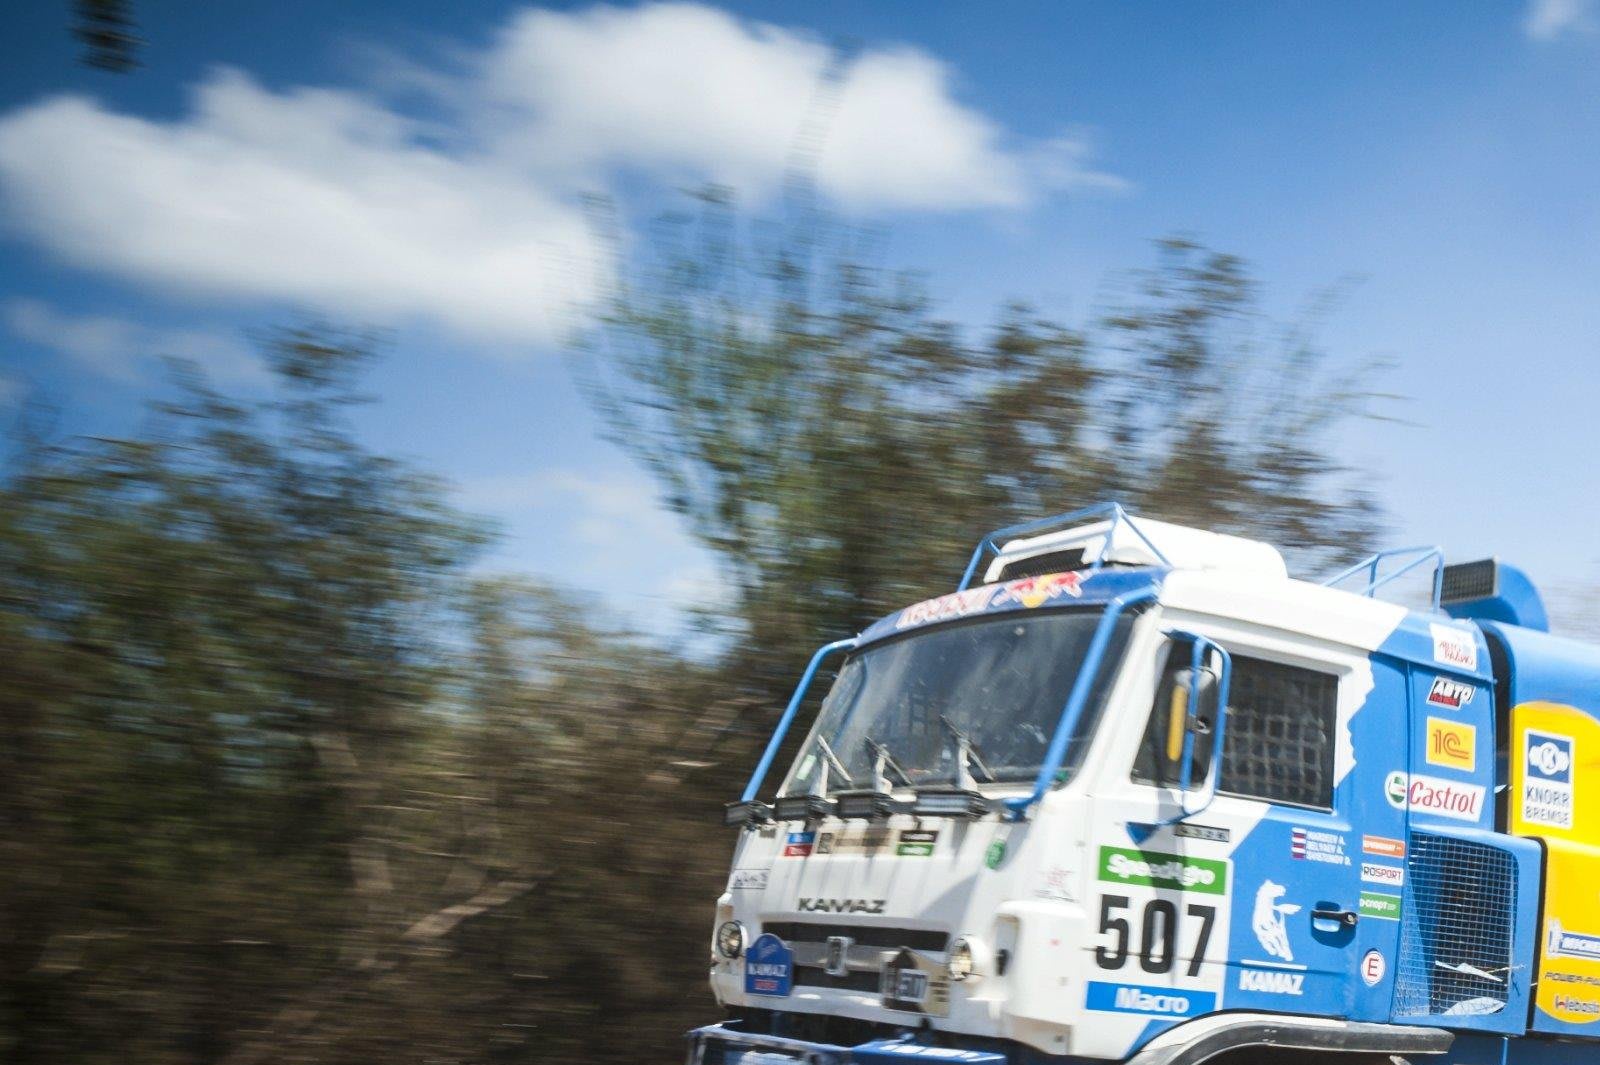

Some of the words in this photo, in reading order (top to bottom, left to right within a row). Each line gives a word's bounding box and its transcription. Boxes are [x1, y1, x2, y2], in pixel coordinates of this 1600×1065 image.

[1410, 781, 1476, 815] Castrol
[1526, 785, 1569, 807] KNORR
[1525, 805, 1569, 824] BREMSE
[798, 898, 887, 914] KAMAZ
[1096, 894, 1216, 978] 507
[1367, 957, 1379, 977] E
[1239, 970, 1305, 996] KAMAZ
[1115, 987, 1190, 1014] Macro
